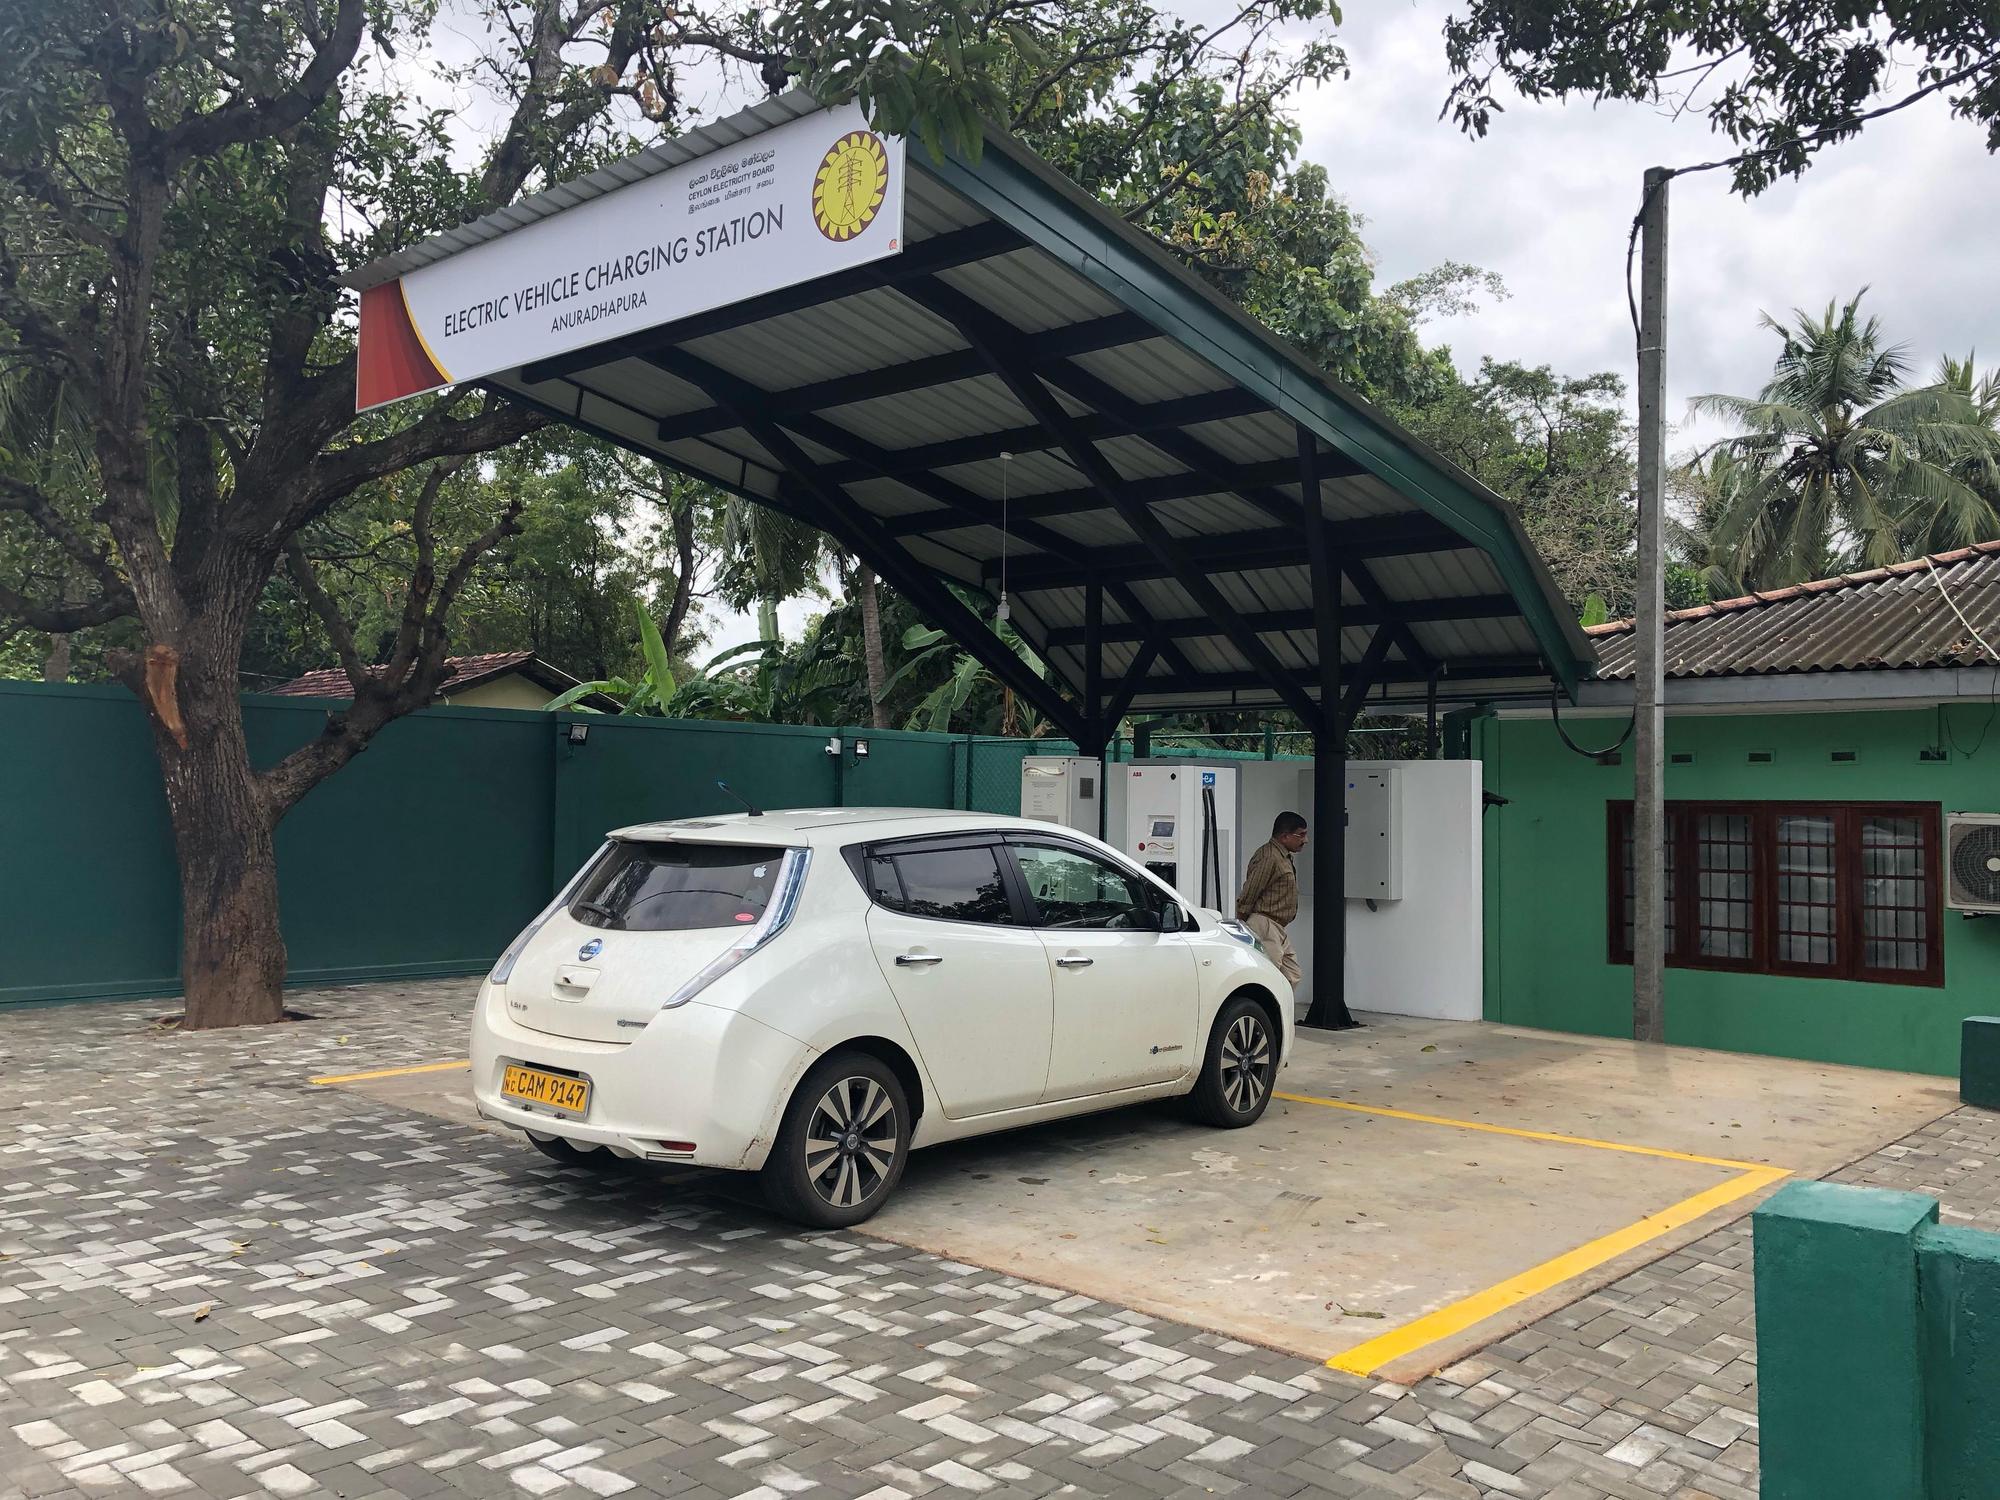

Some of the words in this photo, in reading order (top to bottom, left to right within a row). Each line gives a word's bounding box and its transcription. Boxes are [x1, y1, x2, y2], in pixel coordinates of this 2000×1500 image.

[688, 186, 712, 201] CEYLON
[713, 172, 751, 192] ELECTRICITY
[752, 164, 775, 178] BOARD
[444, 296, 509, 337] ELECTRIC
[514, 273, 579, 315] VEHICLE
[585, 237, 689, 291] CHARGING
[695, 204, 784, 257] STATION
[551, 291, 648, 333] ANURADHAPURA
[517, 1072, 546, 1099] CAM
[550, 1080, 586, 1107] 9147
